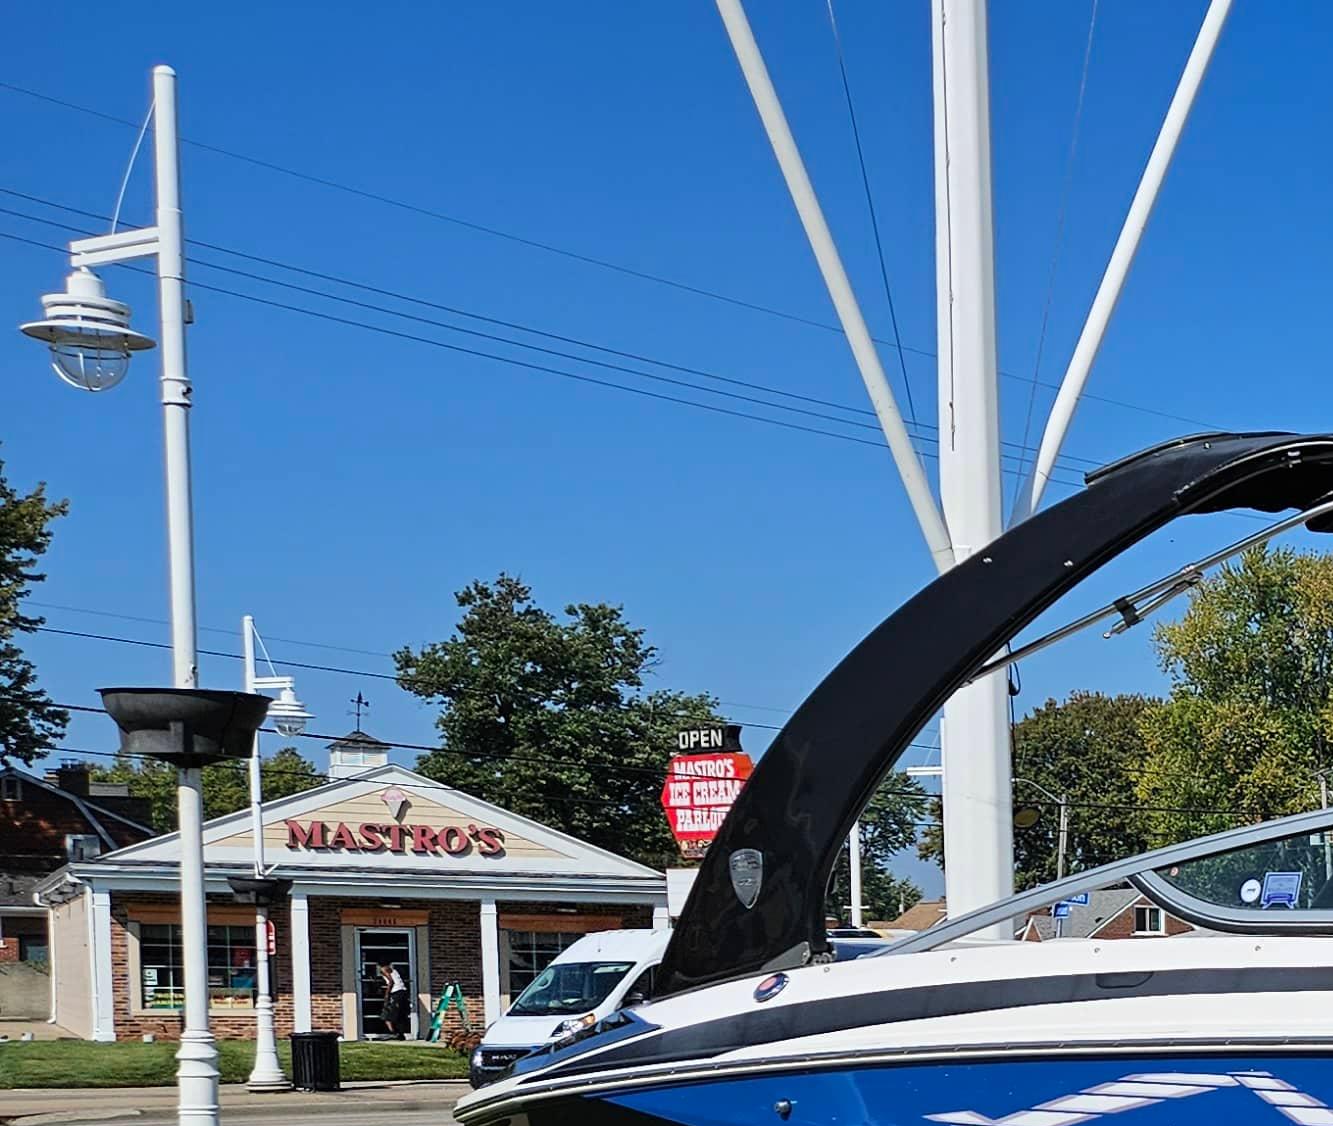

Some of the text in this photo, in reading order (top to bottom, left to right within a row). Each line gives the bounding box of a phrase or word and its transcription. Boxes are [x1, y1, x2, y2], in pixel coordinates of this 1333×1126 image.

[678, 728, 723, 749] OPEN
[673, 758, 735, 780] MASTRO'S
[669, 781, 691, 806] ICE
[285, 819, 506, 857] MASTRO'S
